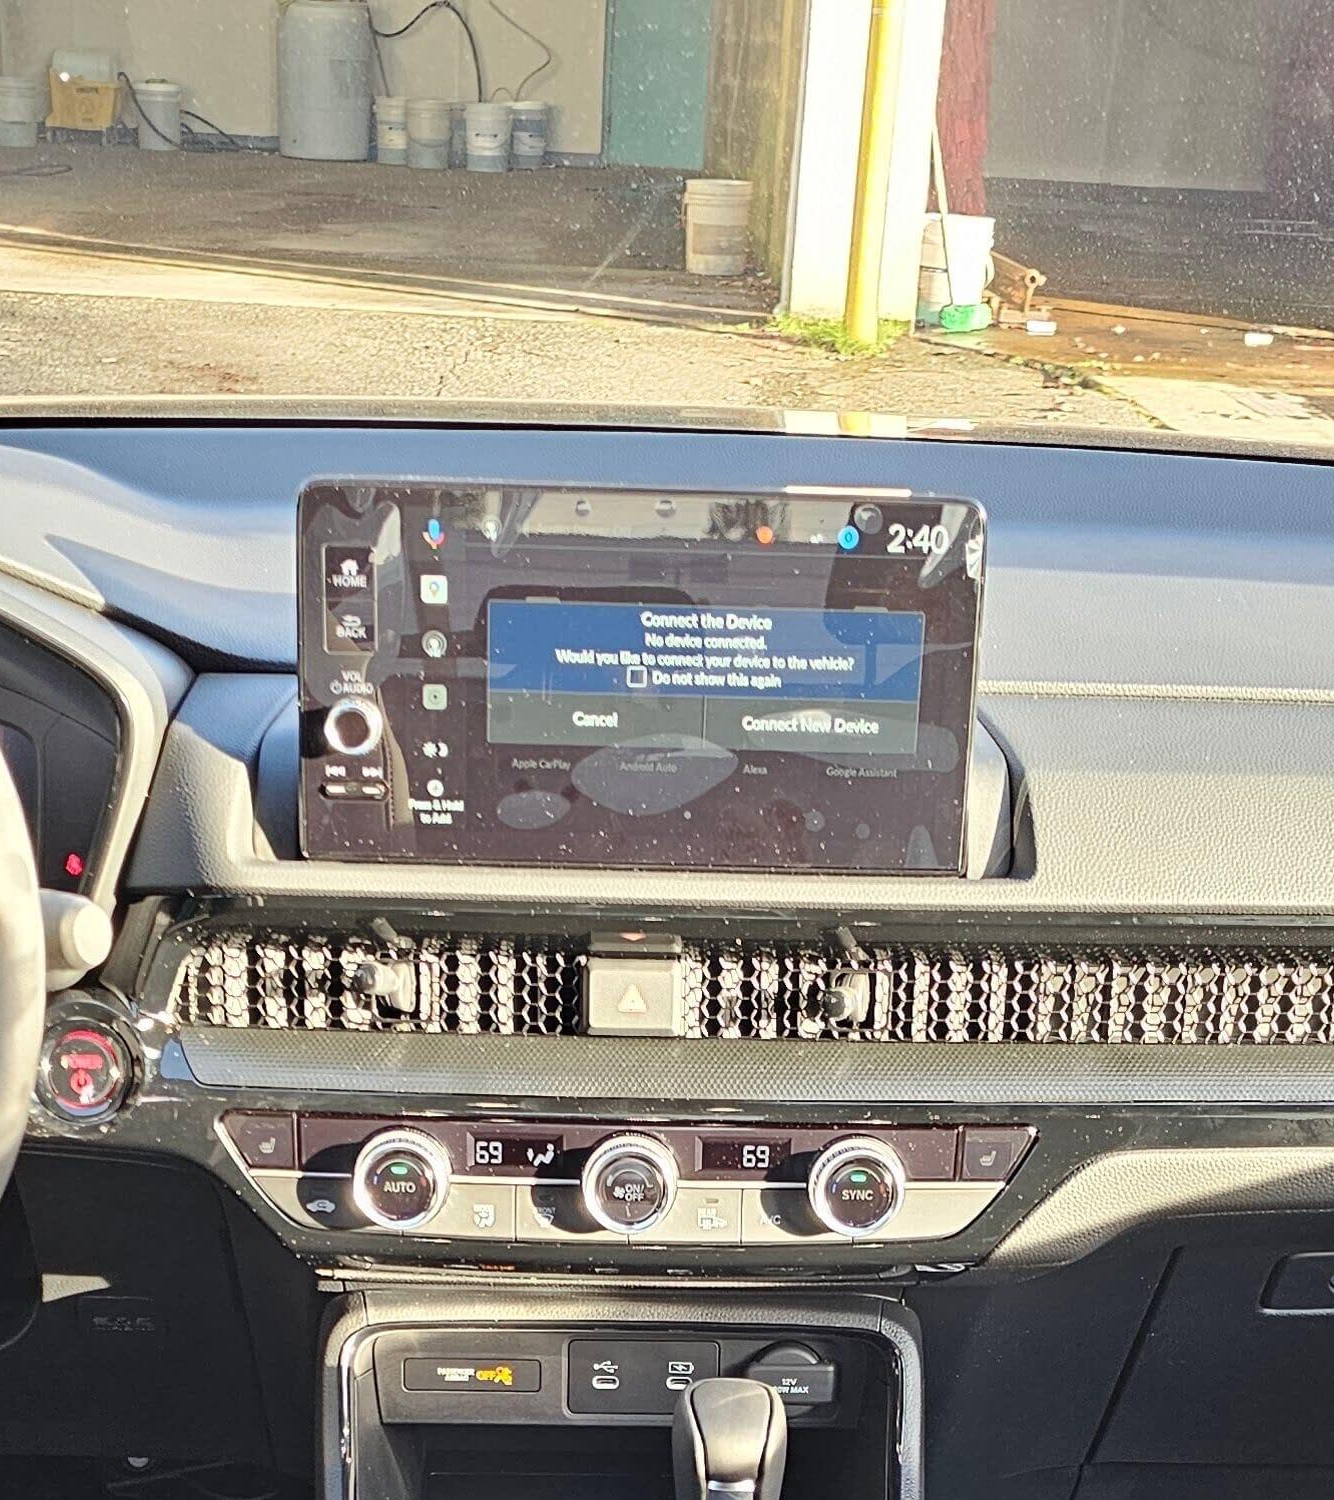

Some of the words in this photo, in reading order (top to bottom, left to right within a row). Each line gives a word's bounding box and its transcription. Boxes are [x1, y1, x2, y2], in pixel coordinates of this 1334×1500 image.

[886, 522, 949, 554] 2:40
[331, 574, 367, 588] HOME
[639, 611, 699, 629] Connect
[700, 613, 724, 630] the
[725, 613, 773, 631] Device
[335, 625, 367, 640] BACK
[644, 632, 664, 648] No
[665, 632, 702, 649] device
[555, 648, 595, 665] Would
[596, 650, 619, 667] you
[619, 650, 641, 665] like
[642, 651, 657, 666] to
[657, 653, 703, 667] connect
[704, 655, 732, 670] your
[733, 654, 771, 670] device
[772, 656, 786, 670] to
[787, 656, 808, 671] the
[809, 656, 855, 672] vehicle?
[341, 670, 364, 683] VOL
[652, 671, 671, 686] Do
[672, 673, 693, 686] not
[694, 673, 725, 687] show
[726, 673, 749, 688] this
[750, 674, 782, 690] again
[342, 682, 375, 695] AUDIO
[571, 711, 619, 728] Cancel
[741, 715, 799, 733] Connect
[800, 716, 832, 734] New
[833, 717, 880, 735] Device
[511, 758, 538, 771] Apple
[619, 761, 653, 773] Android
[654, 763, 678, 774] Auto
[742, 764, 768, 776] Alexa
[825, 766, 856, 779] Google
[857, 766, 899, 779] Assistant
[475, 1141, 503, 1165] 69
[742, 1145, 770, 1169] 69
[383, 1181, 416, 1194] AUTO
[624, 1192, 645, 1203] OFF
[841, 1189, 874, 1201] SYNC
